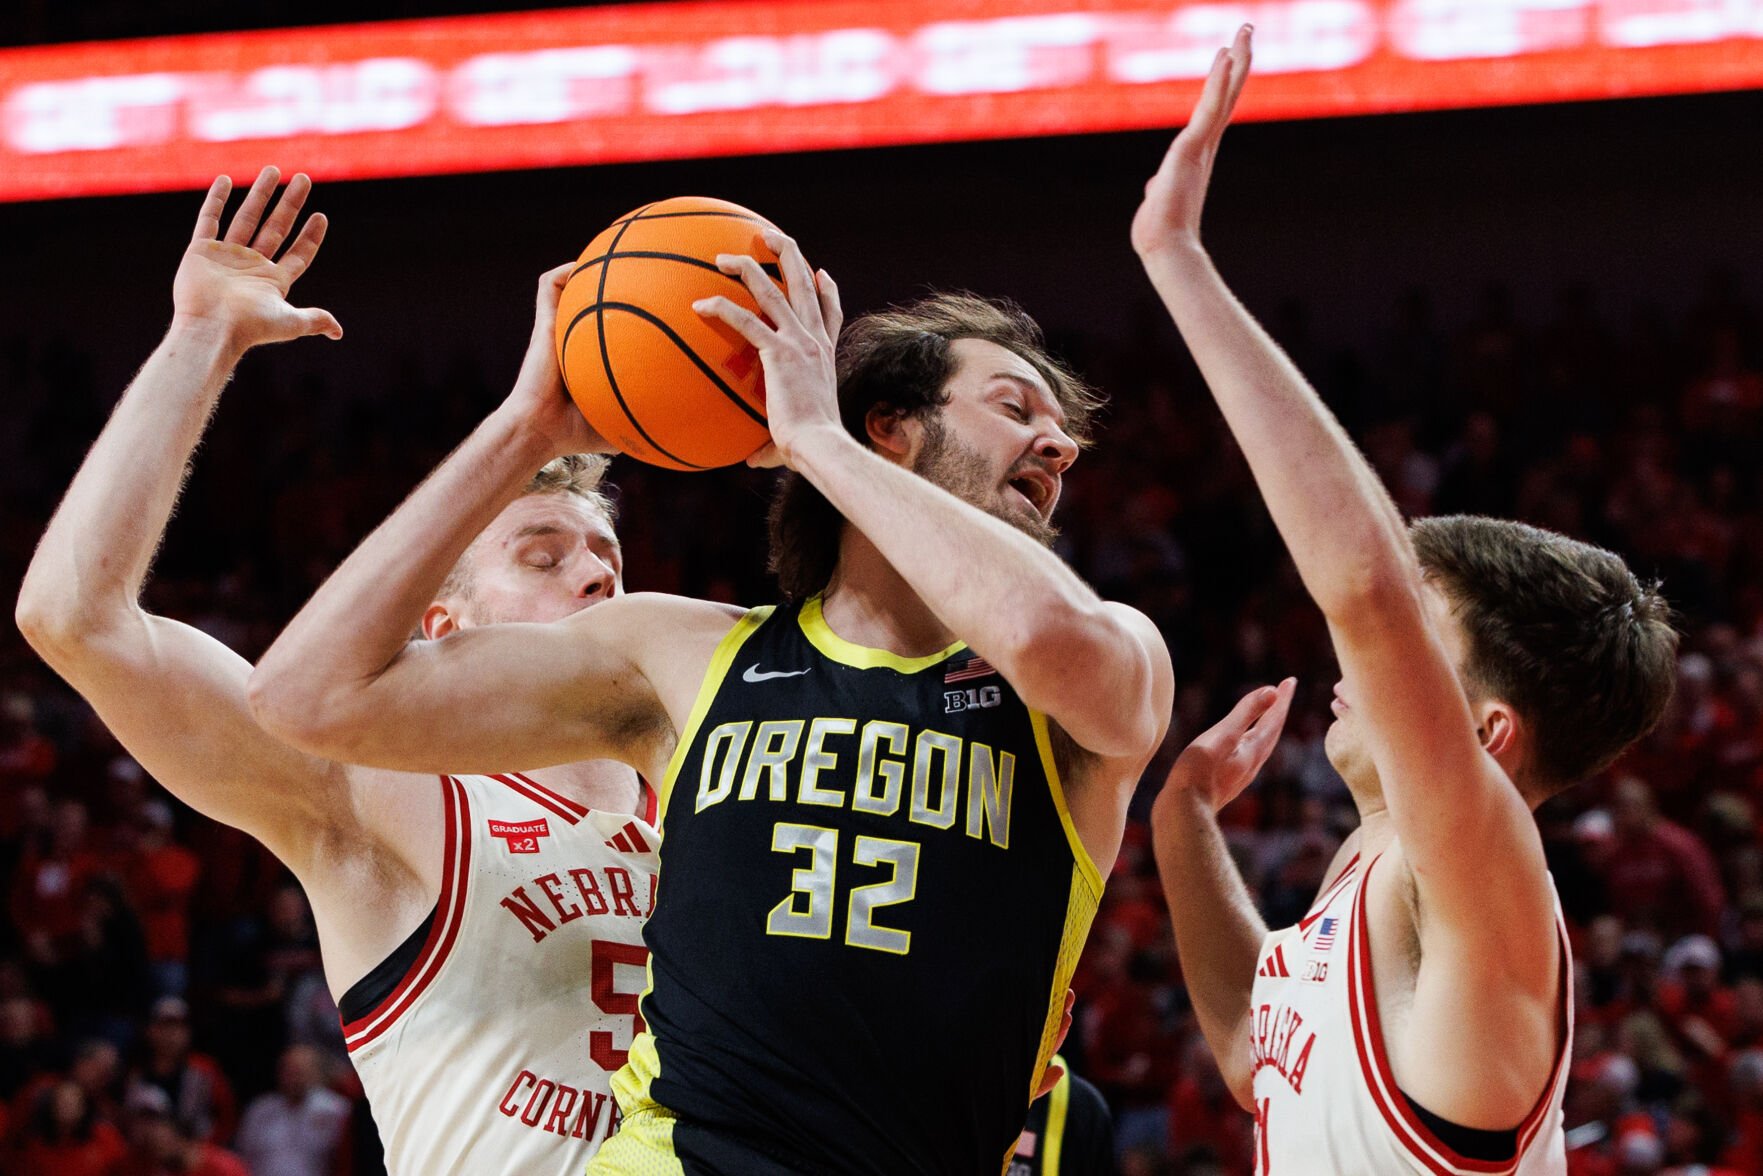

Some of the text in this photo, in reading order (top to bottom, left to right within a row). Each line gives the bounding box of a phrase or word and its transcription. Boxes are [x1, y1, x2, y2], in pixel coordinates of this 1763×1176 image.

[491, 824, 547, 834] GRADUATE
[695, 717, 1016, 850] OREGON
[766, 822, 921, 955] 32
